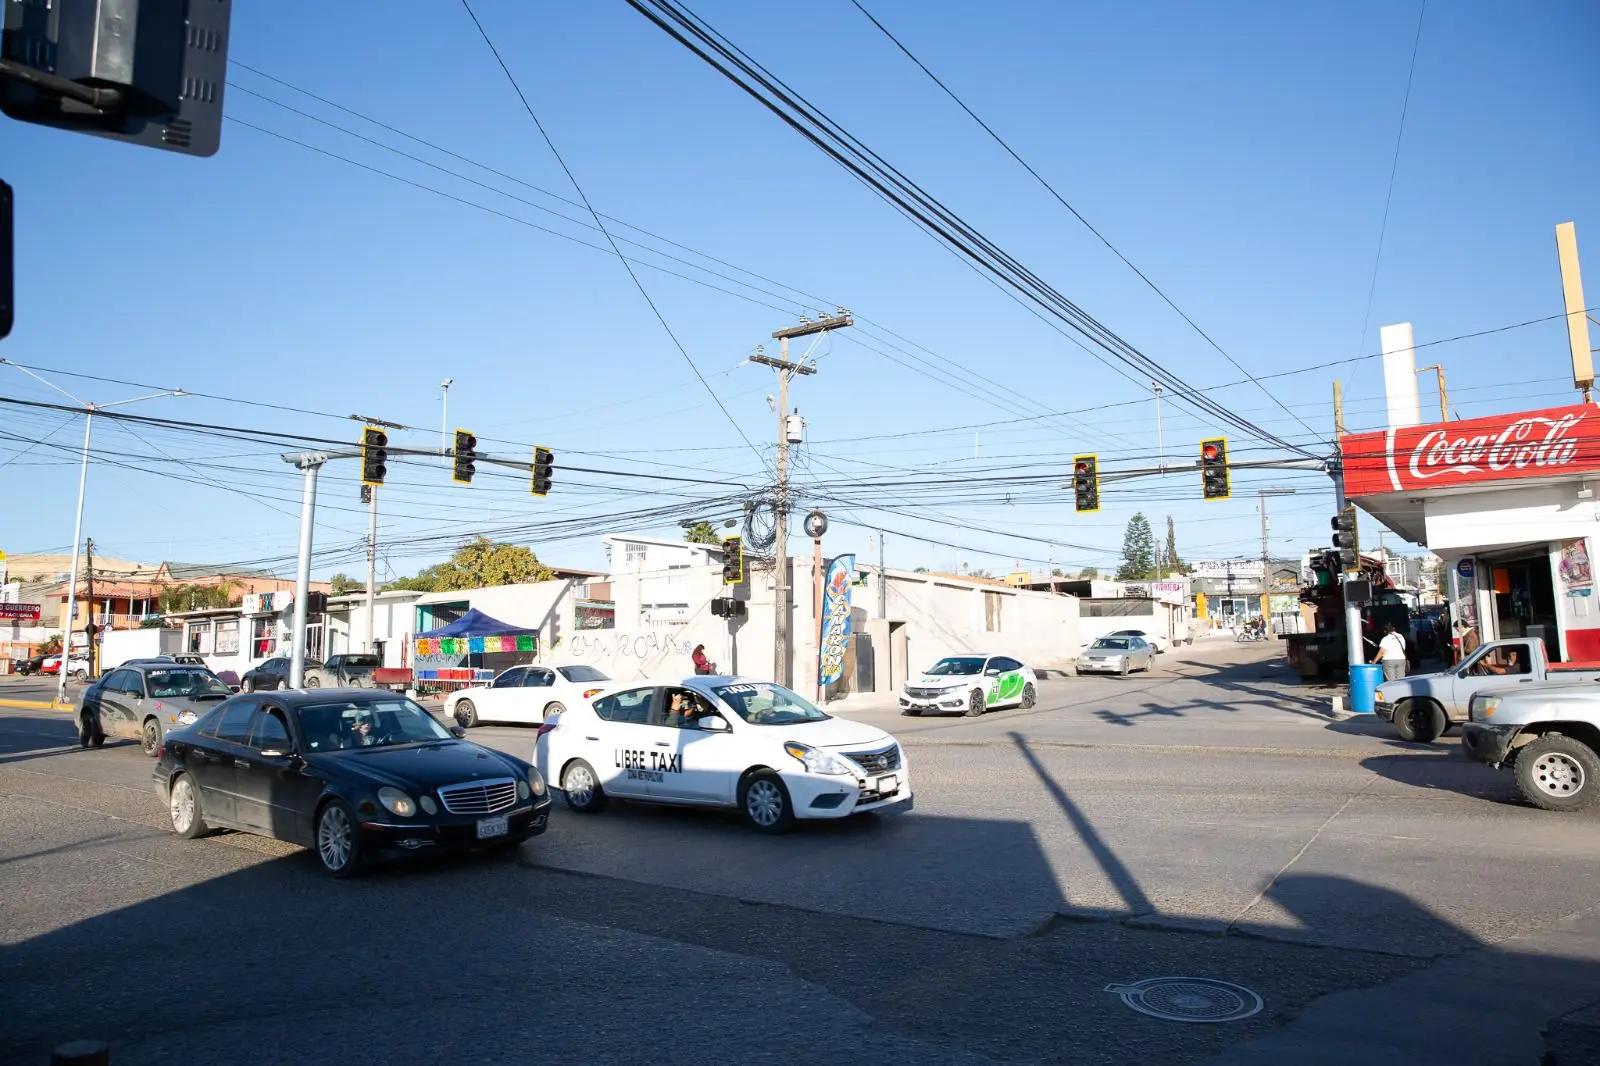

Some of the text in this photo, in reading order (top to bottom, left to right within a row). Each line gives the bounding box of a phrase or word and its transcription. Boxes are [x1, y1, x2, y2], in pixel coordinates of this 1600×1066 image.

[1409, 411, 1587, 479] Coca-Cola
[5, 603, 40, 612] GUERRERO
[615, 748, 683, 774] LIBRE TAXI
